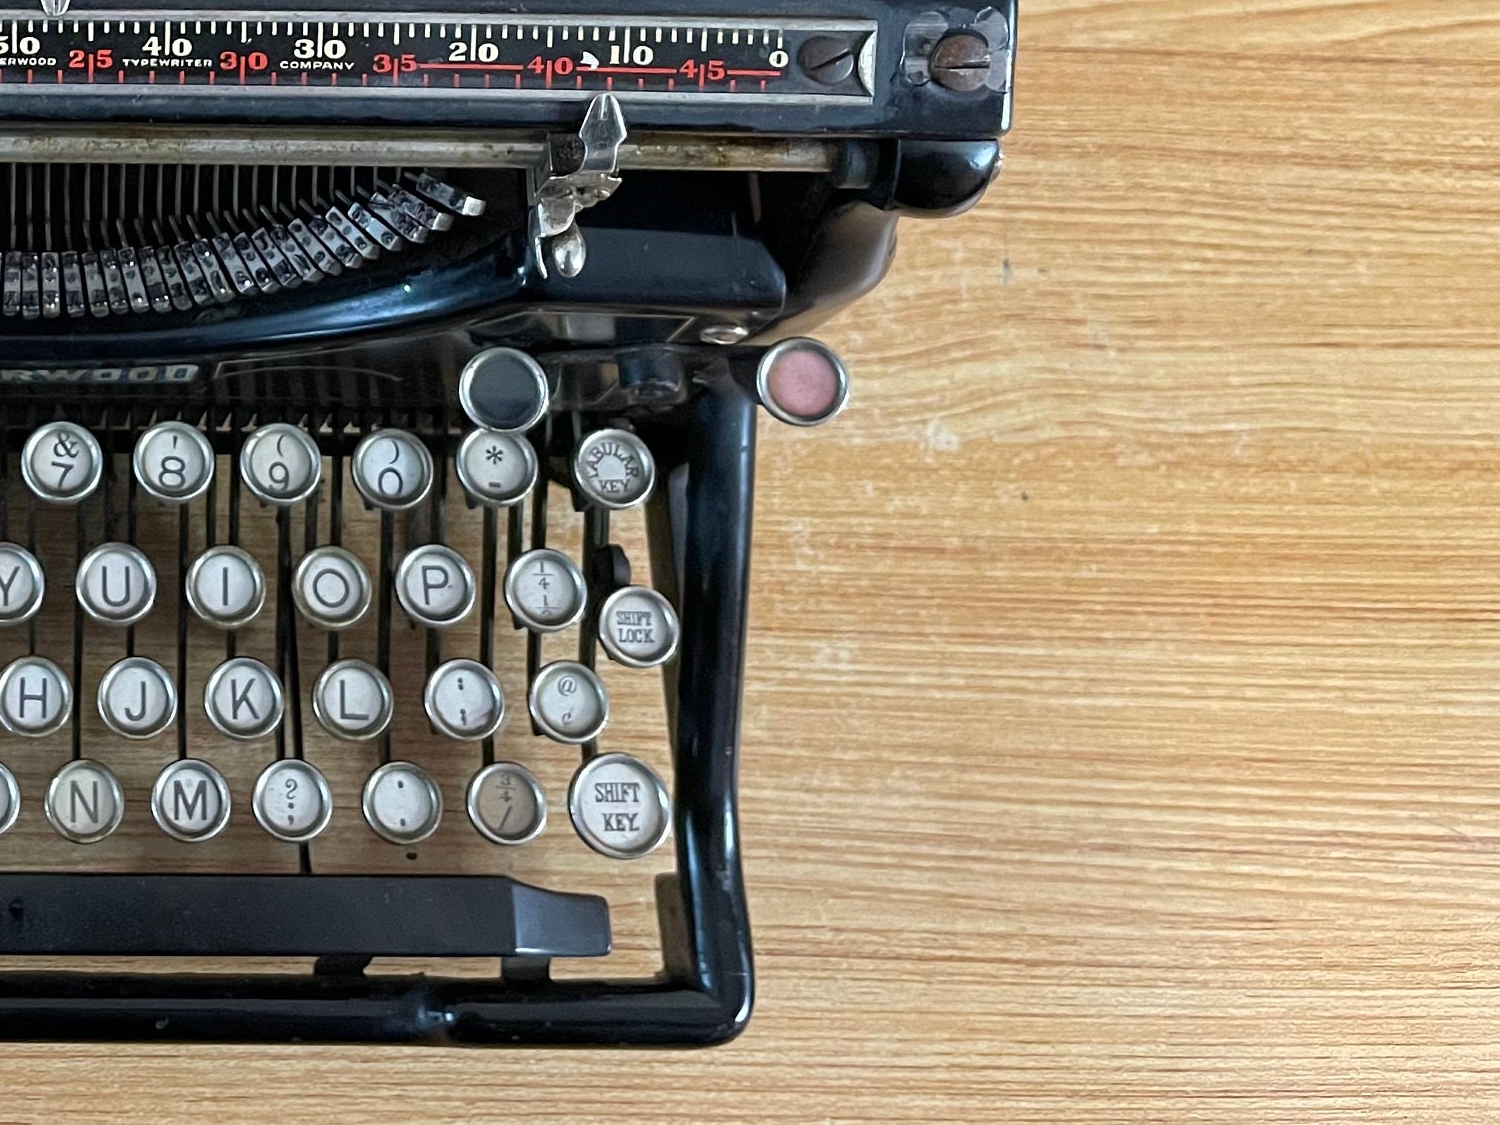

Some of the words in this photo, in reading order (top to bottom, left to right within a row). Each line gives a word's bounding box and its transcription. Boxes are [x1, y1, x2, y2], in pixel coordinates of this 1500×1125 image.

[68, 49, 113, 69] 25
[219, 51, 269, 70] 30
[373, 54, 418, 73] 35
[527, 57, 573, 76] 40
[680, 60, 725, 81] 45
[122, 58, 212, 67] TYPEWRITER
[279, 61, 354, 70] COMPANY
[142, 37, 193, 56] 40
[294, 39, 346, 58] 30
[448, 42, 499, 62] 20
[609, 45, 654, 65] 10
[768, 50, 789, 67] 0
[53, 432, 79, 459] &
[51, 461, 75, 488] 7
[158, 456, 186, 488] 8
[268, 461, 290, 491] 9
[598, 479, 631, 492] KEY
[101, 565, 131, 607] U
[313, 567, 350, 608] O
[421, 564, 450, 606] P
[615, 611, 652, 626] SHIFT
[618, 628, 655, 643] LOCK
[18, 677, 49, 719] H
[124, 680, 148, 723] J
[230, 678, 261, 721] K
[339, 679, 370, 722] L
[557, 674, 579, 697] @
[69, 779, 100, 824] N
[173, 779, 208, 822] M
[284, 777, 299, 811] ?
[593, 782, 642, 804] SHIFT
